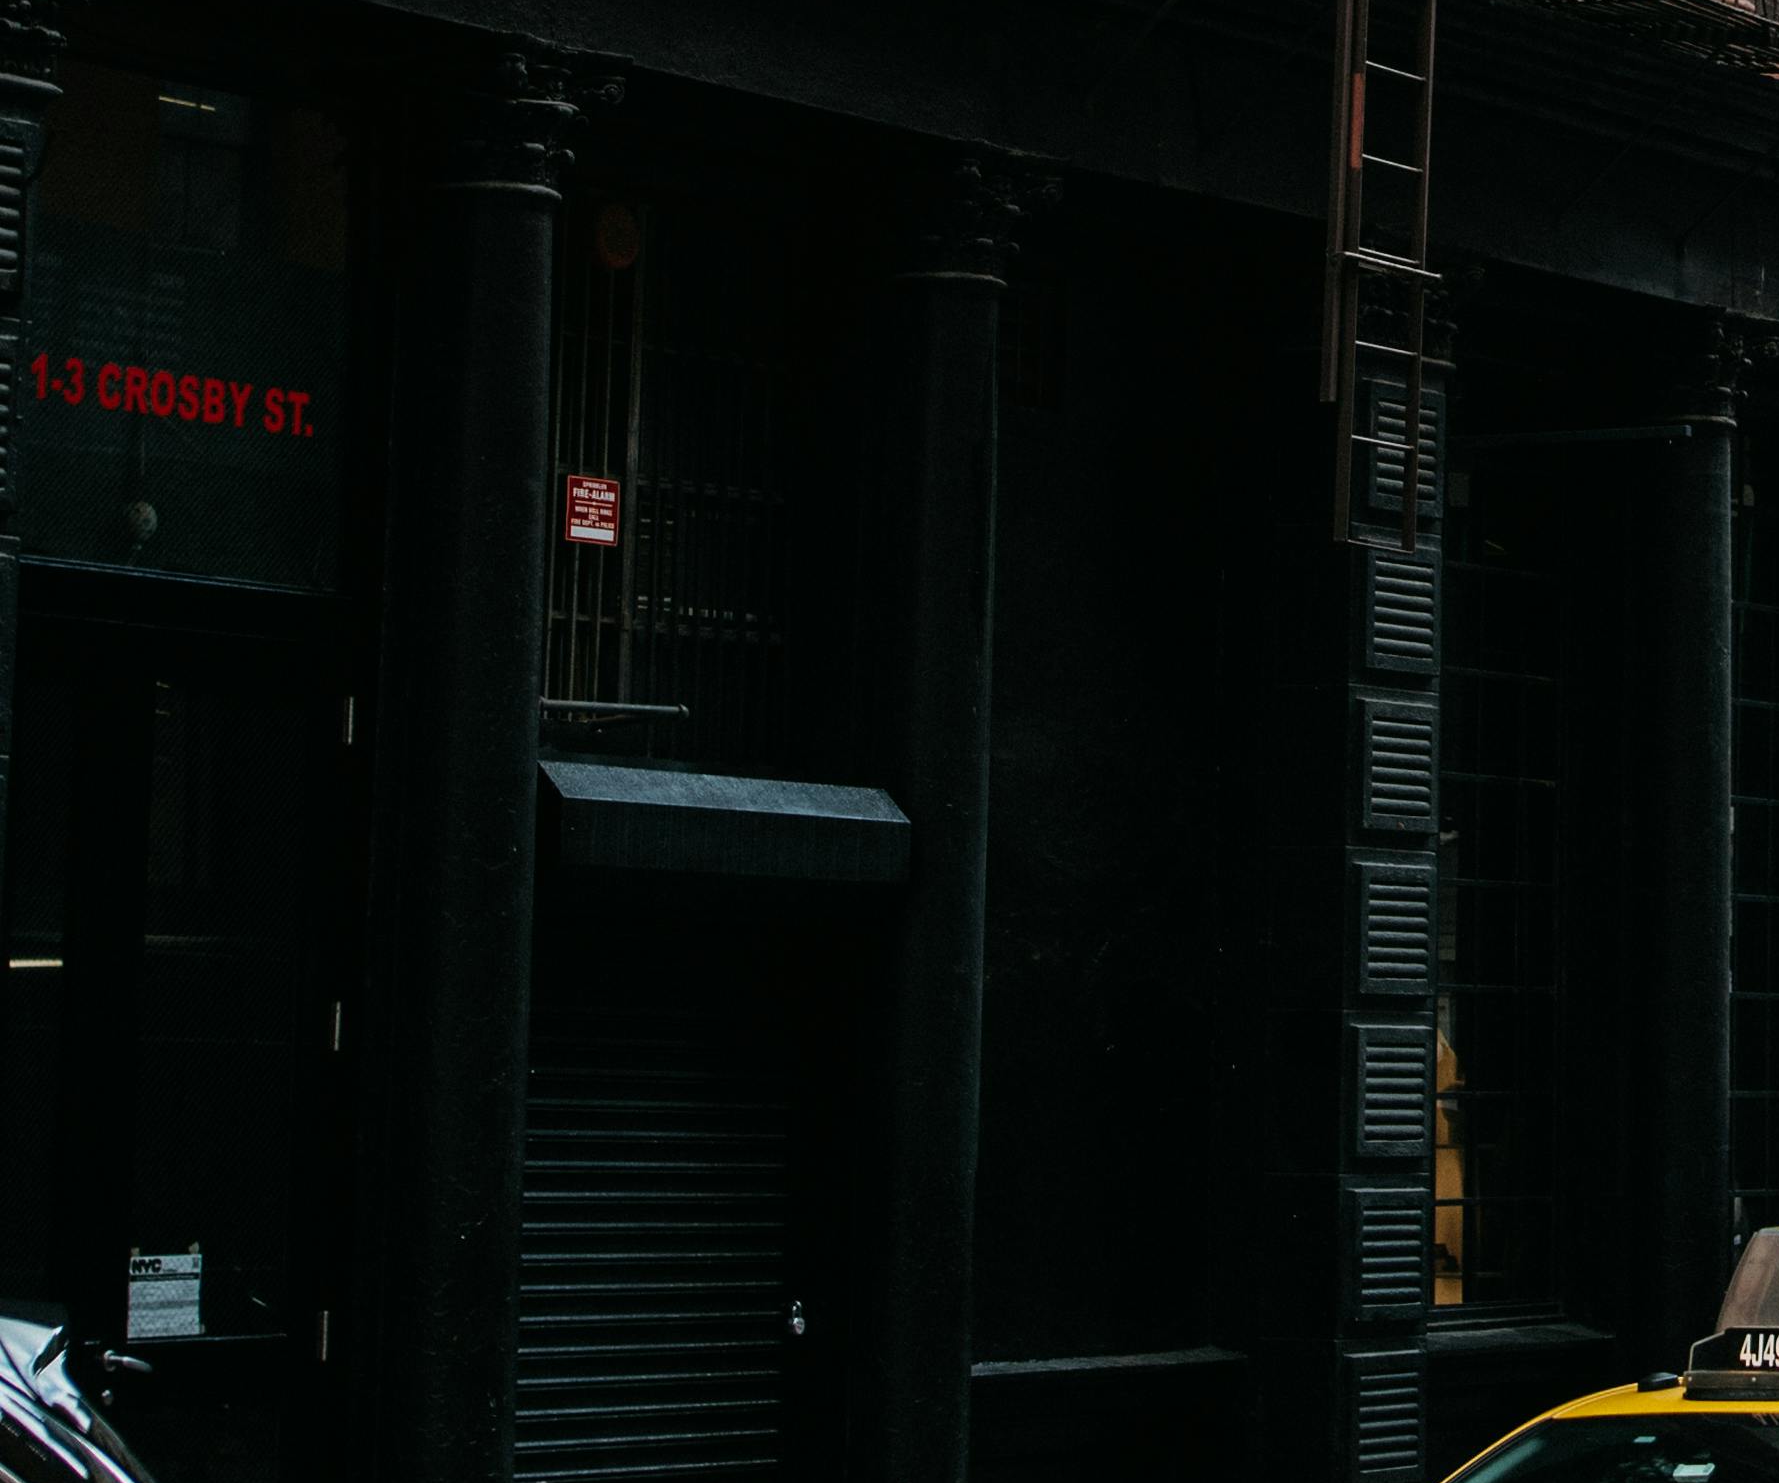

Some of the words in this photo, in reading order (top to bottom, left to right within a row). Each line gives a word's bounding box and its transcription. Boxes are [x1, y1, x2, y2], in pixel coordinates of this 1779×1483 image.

[31, 352, 85, 405] 1-3
[98, 362, 254, 428] CROSBY
[263, 387, 313, 437] ST.
[132, 1259, 162, 1274] NYC
